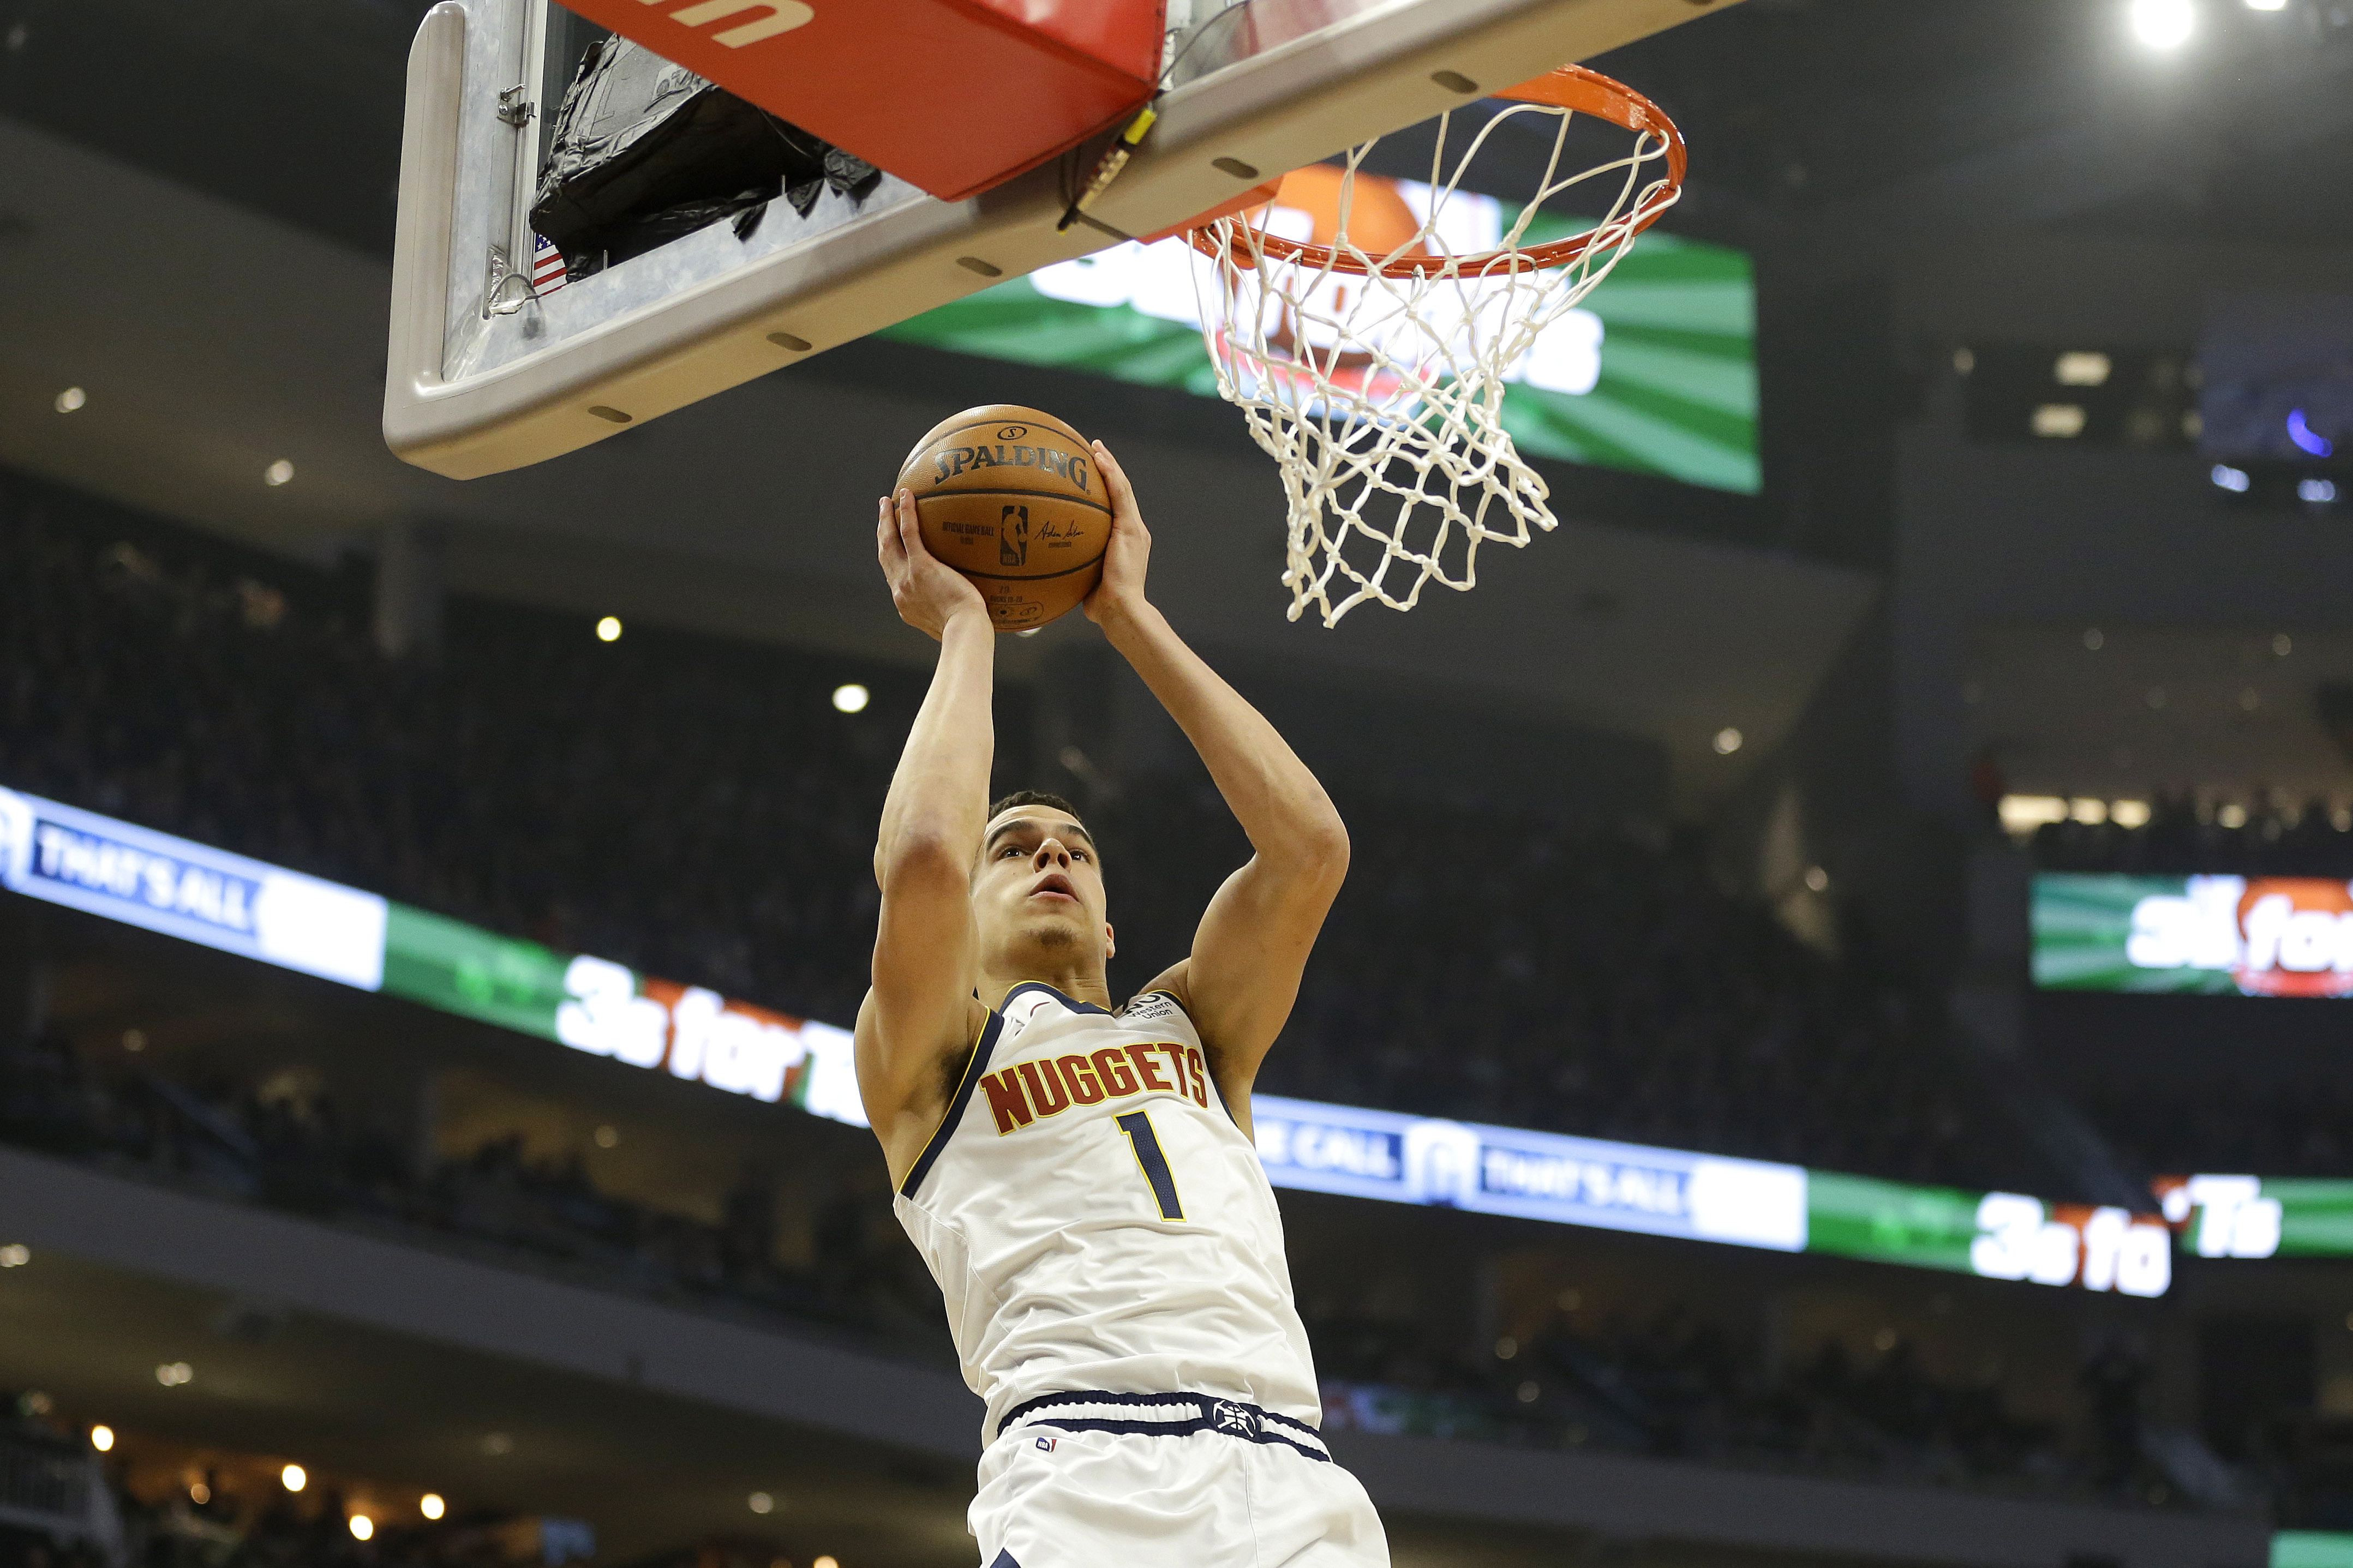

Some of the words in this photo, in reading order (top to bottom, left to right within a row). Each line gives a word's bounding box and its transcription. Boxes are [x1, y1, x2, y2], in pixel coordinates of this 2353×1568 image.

[934, 444, 1088, 492] SPALDING
[1003, 554, 1017, 564] NBA
[1128, 1001, 1172, 1018] Western
[1142, 1009, 1173, 1019] Union
[668, 986, 807, 1103] for
[980, 1042, 1208, 1137] NUGGETS
[1112, 1109, 1188, 1223] 1
[1037, 1440, 1048, 1449] NBA
